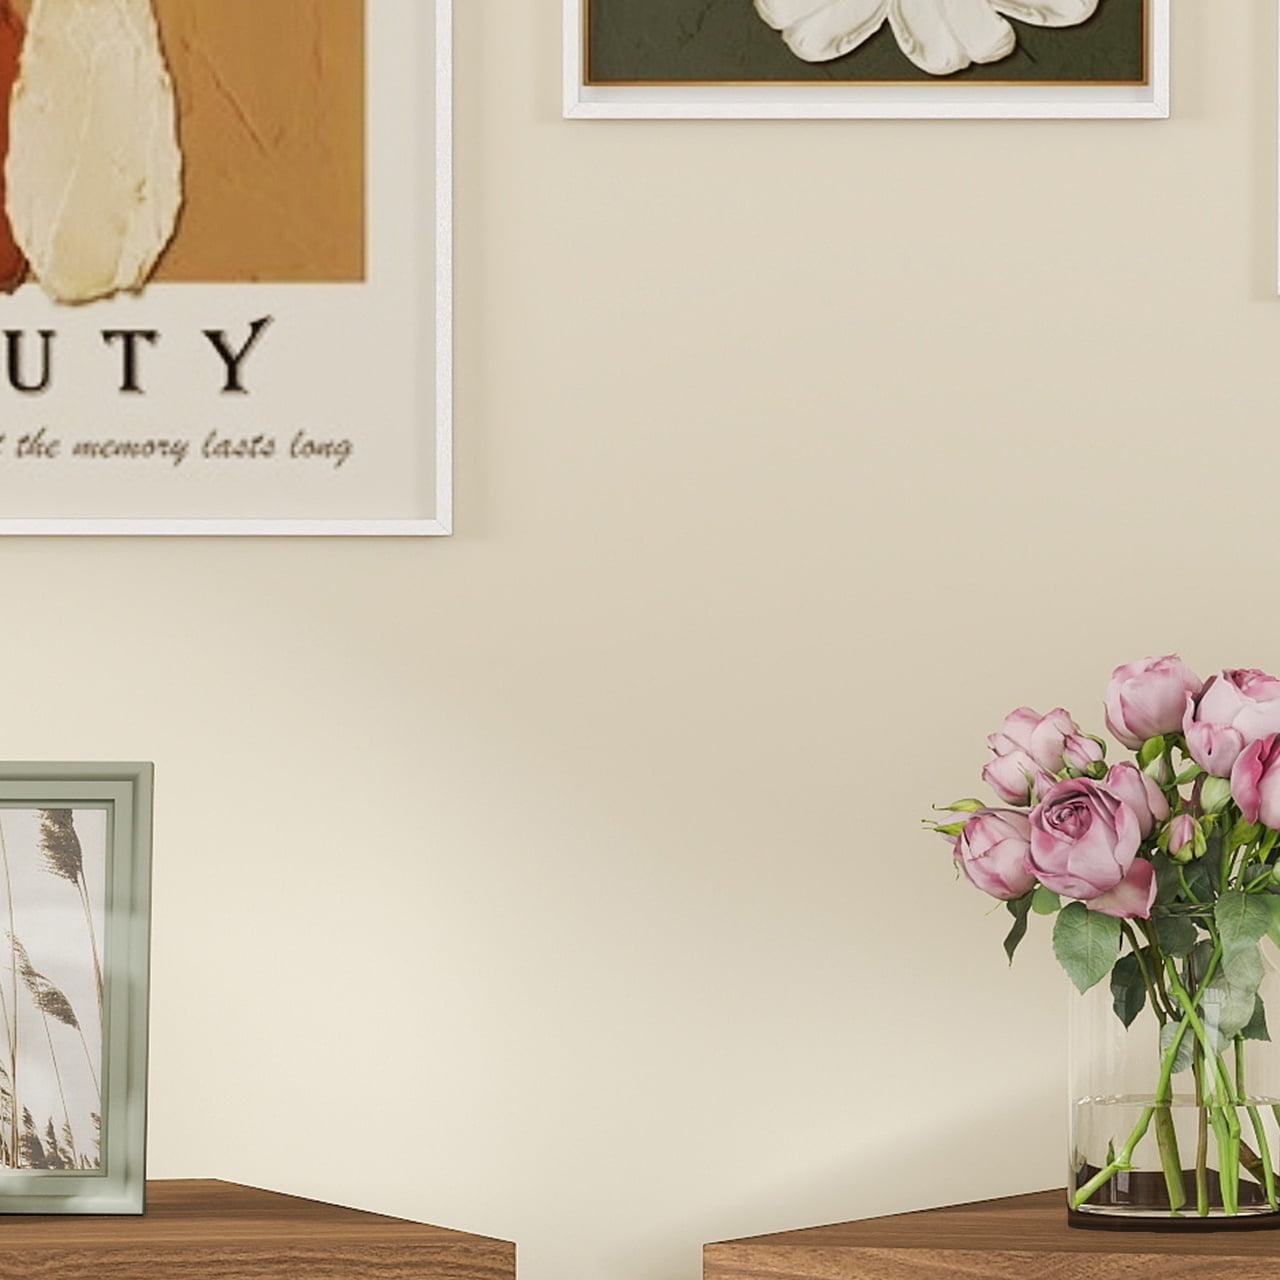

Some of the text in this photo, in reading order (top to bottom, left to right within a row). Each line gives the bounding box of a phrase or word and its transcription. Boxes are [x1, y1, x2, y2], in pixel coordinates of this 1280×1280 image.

[14, 427, 62, 460] the
[73, 437, 191, 468] memory
[201, 427, 277, 460] lasts
[288, 427, 356, 468] long
